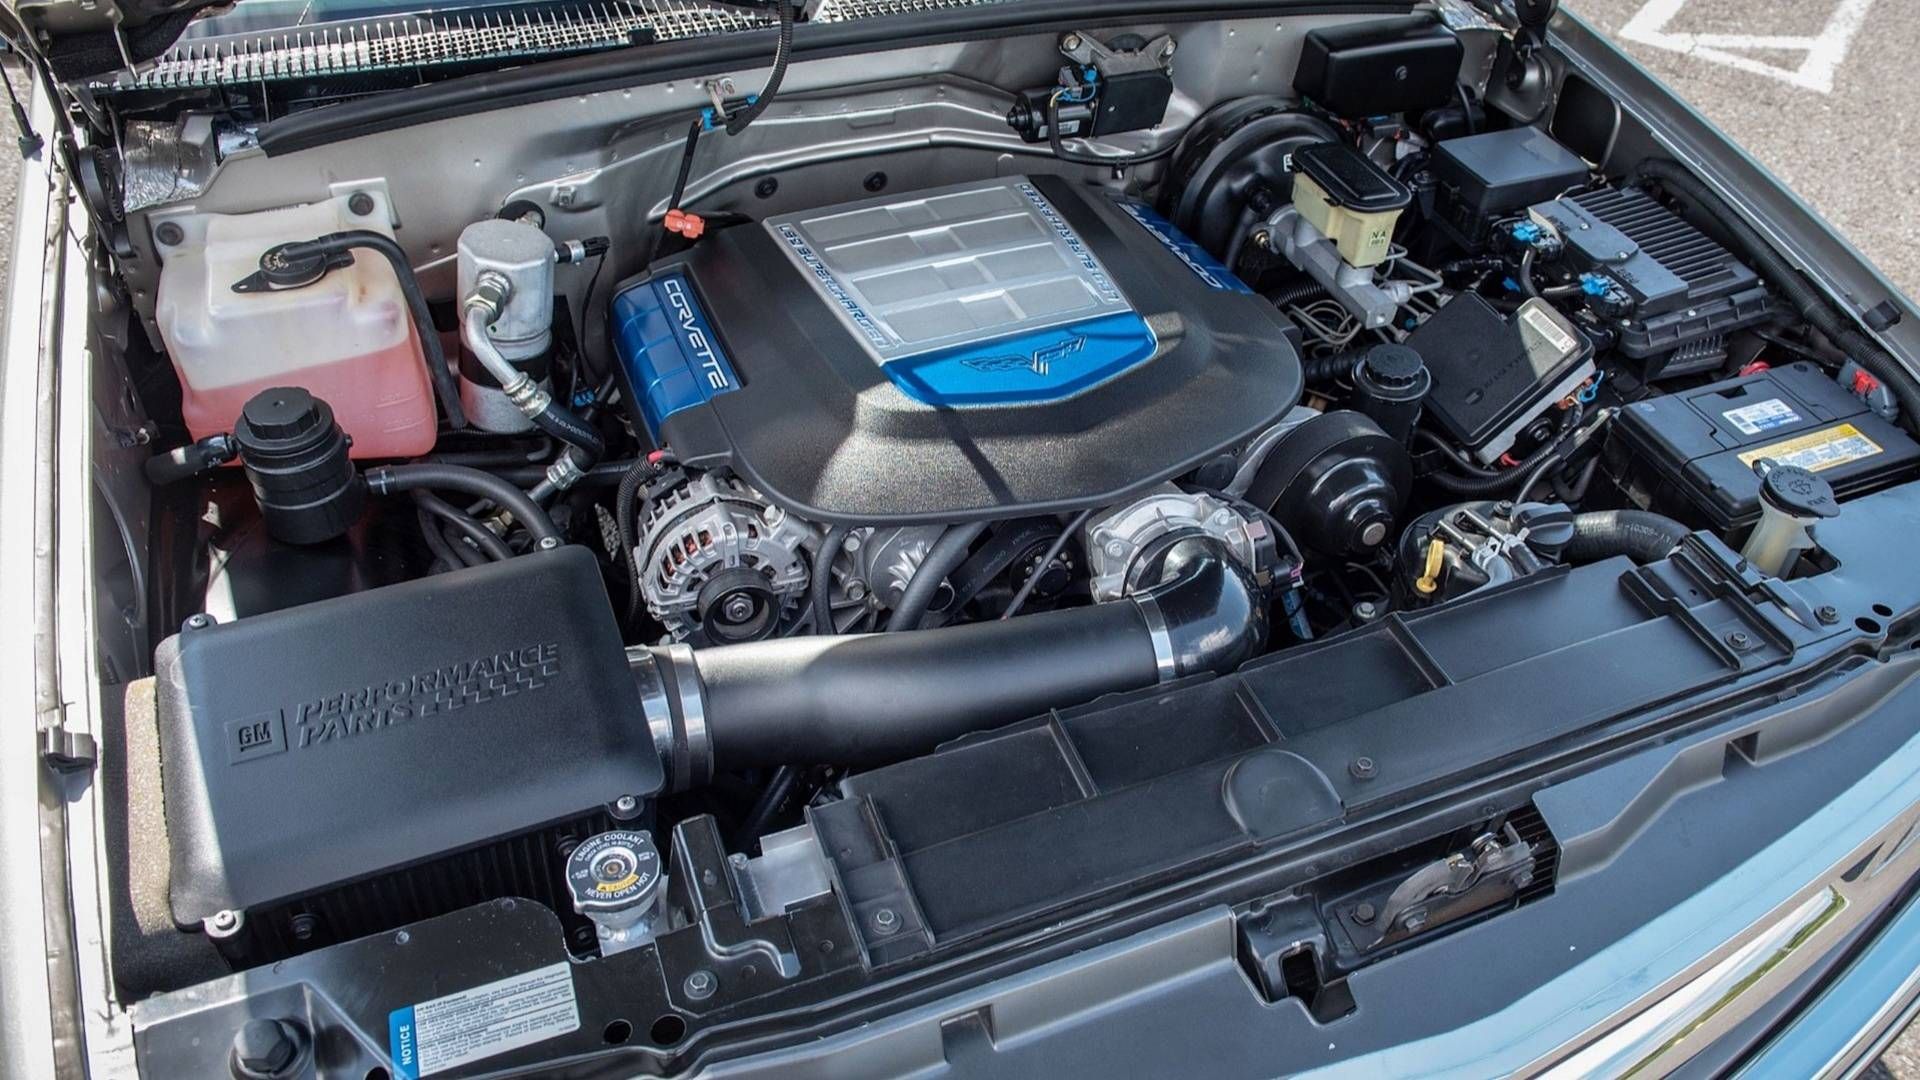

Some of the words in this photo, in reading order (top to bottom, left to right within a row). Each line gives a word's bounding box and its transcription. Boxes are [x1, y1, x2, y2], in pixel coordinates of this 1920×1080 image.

[797, 245, 891, 348] SUPERCHARGED
[663, 279, 729, 389] CORVETTE
[295, 643, 559, 725] PERFORMANCE
[237, 719, 274, 746] GM
[298, 700, 415, 749] PARTS
[575, 838, 603, 861] ENGINE
[604, 833, 644, 845] COOLANT
[585, 887, 612, 900] NEVER
[613, 885, 637, 898] OPEN
[637, 872, 651, 889] HOT
[399, 1023, 413, 1066] NOTICE
